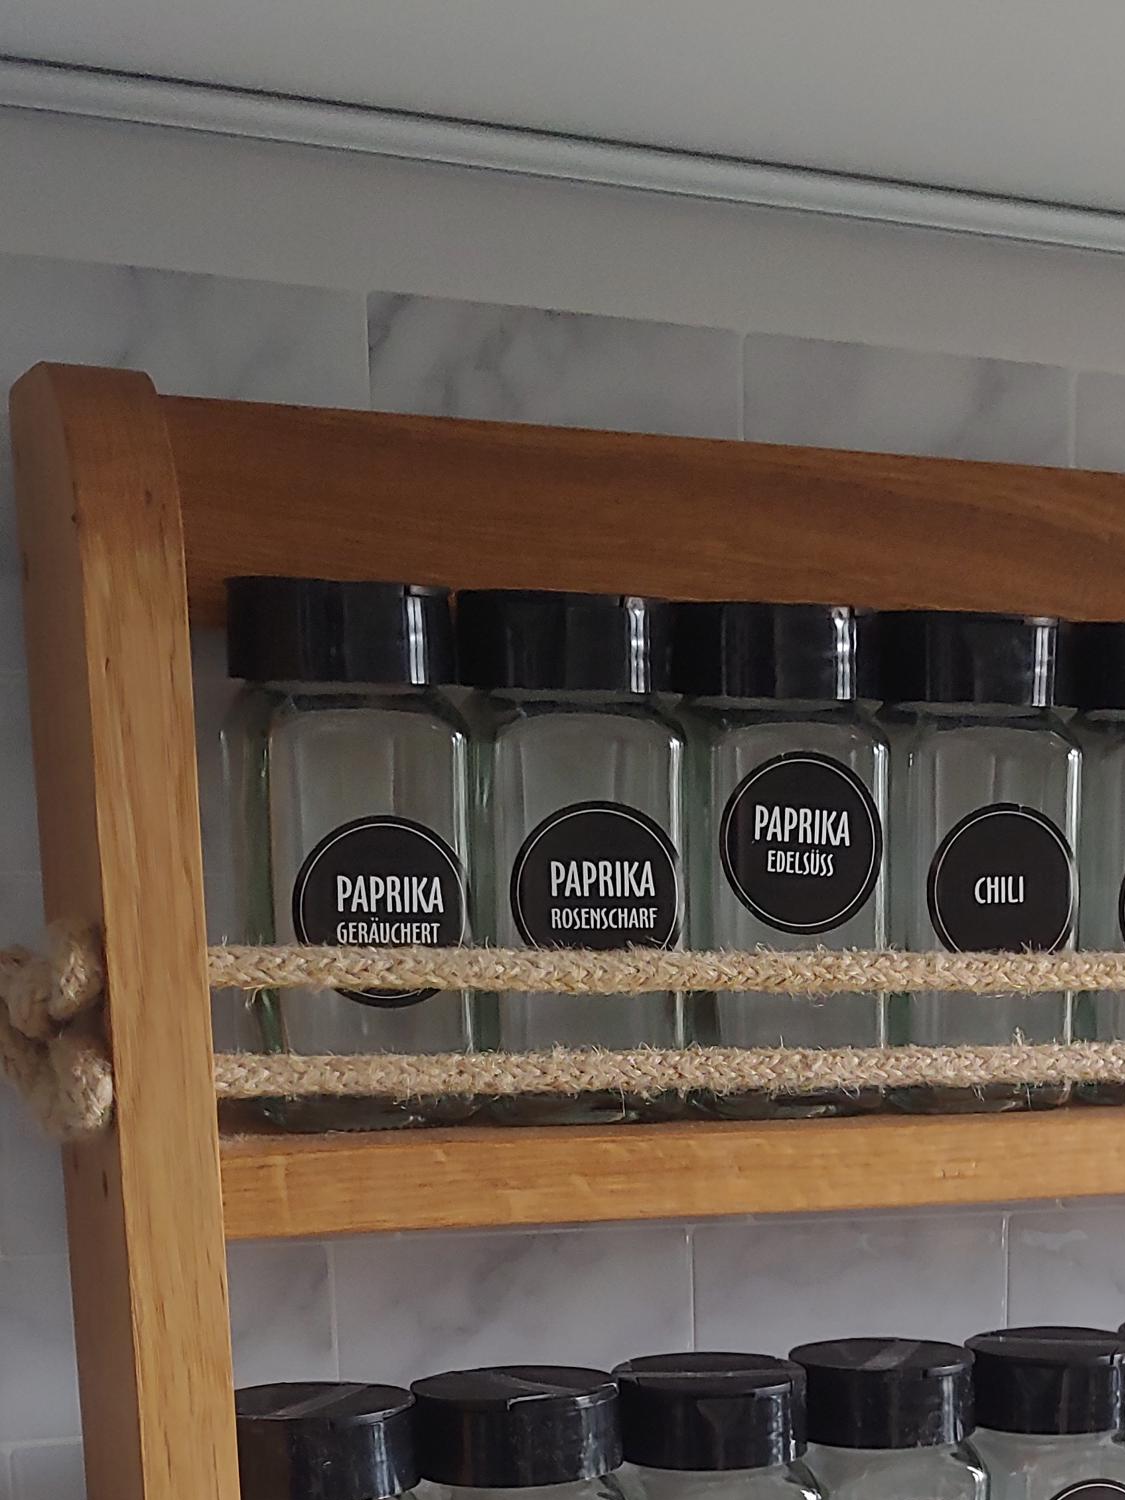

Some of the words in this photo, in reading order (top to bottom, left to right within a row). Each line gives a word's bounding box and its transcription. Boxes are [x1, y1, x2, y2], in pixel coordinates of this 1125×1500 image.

[754, 804, 851, 847] PAPRIKA
[766, 849, 834, 878] EDELSÜSS
[549, 859, 656, 898] PAPRIKA
[974, 876, 1025, 904] CHILI
[336, 875, 445, 914] PAPRIKA
[336, 921, 441, 945] GERÄUCHERT
[550, 907, 659, 931] ROSENSCHARF
